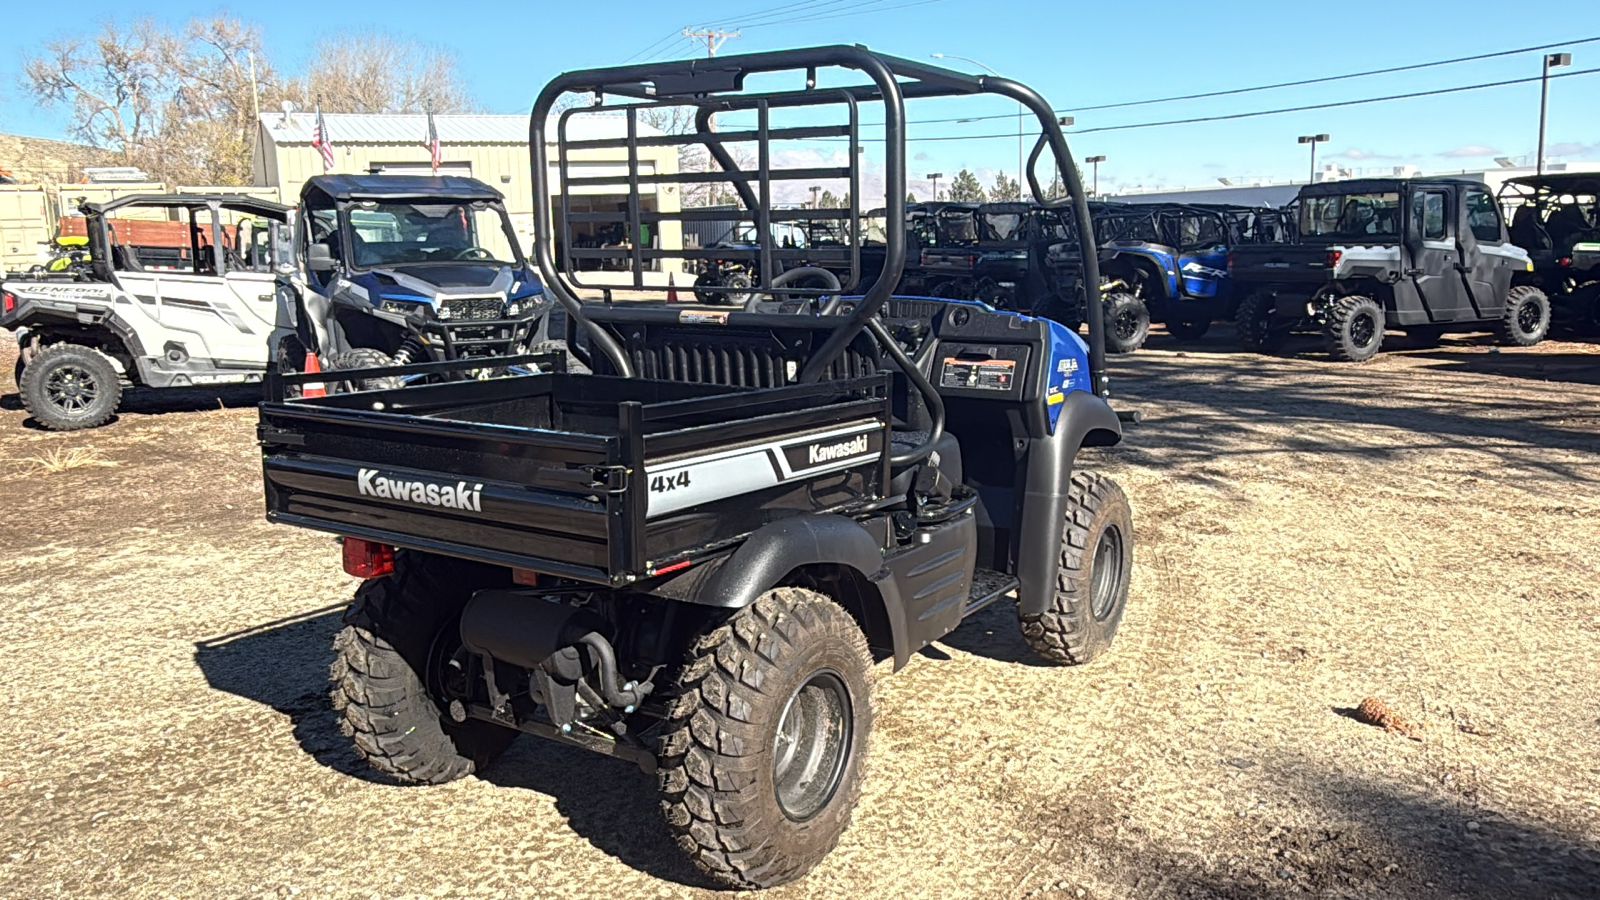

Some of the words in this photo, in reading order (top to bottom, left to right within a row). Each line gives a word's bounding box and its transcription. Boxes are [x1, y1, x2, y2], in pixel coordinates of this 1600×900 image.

[1182, 262, 1227, 279] RZR
[809, 434, 868, 464] Kawasaki
[358, 468, 483, 512] Kawasaki
[650, 470, 691, 493] 4x4
